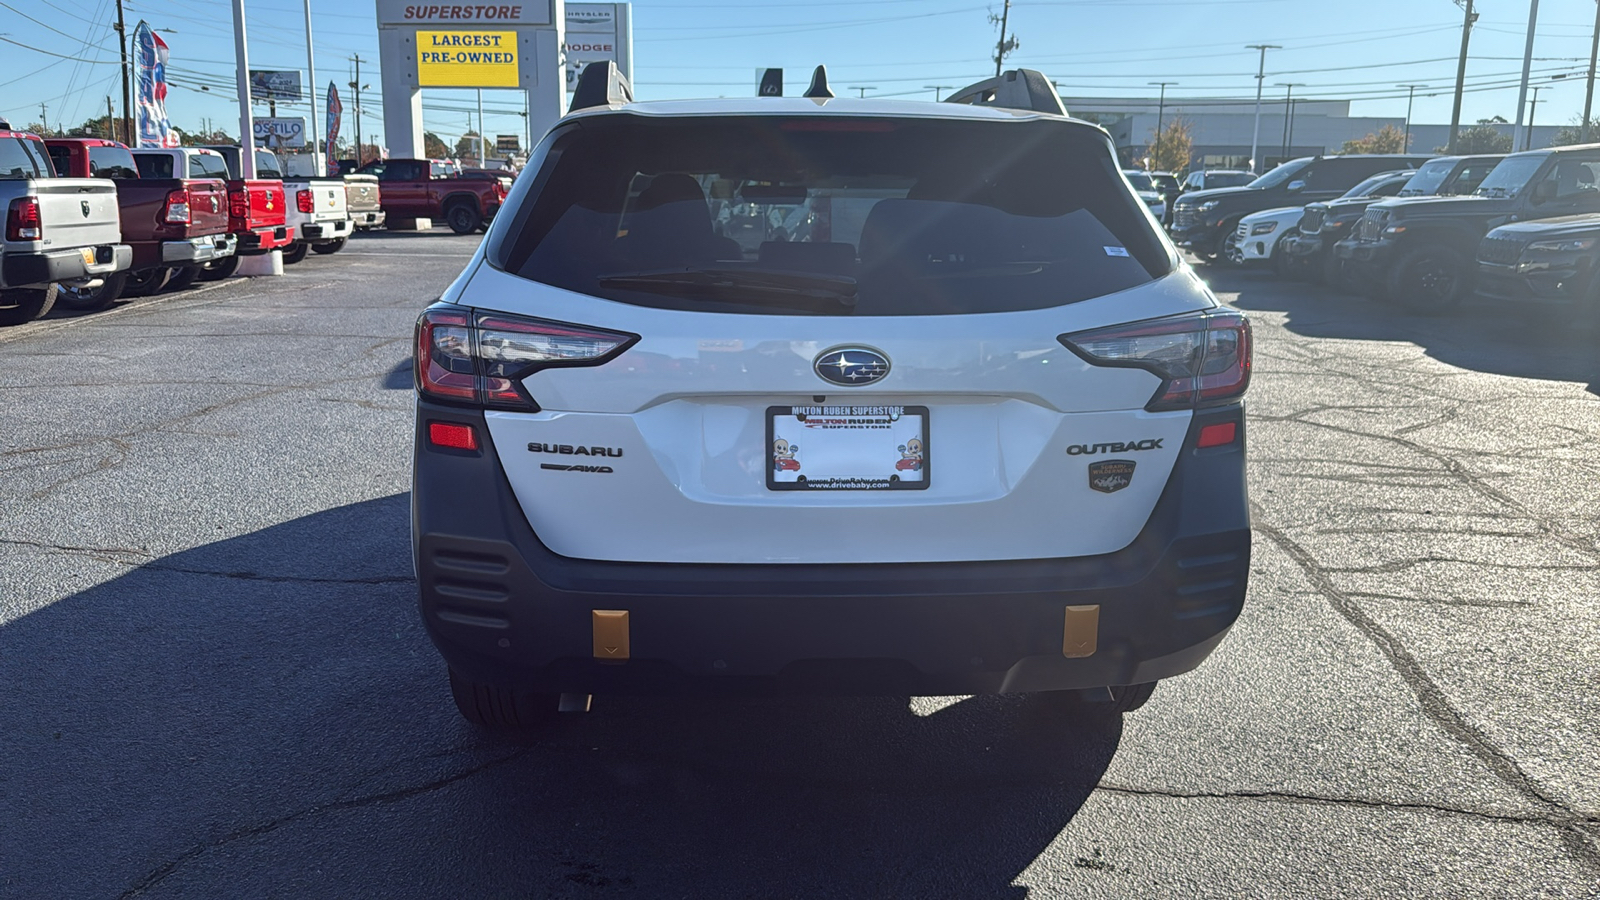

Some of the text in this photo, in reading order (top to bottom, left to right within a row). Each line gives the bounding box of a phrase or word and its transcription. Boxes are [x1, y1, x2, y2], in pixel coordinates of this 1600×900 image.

[404, 5, 522, 19] SUPERSTORE
[432, 35, 502, 47] LARGEST
[421, 52, 514, 64] PRE-OWNED
[792, 407, 905, 415] MILTON RUBEN SUPERSTORE
[527, 442, 622, 457] SUBARU
[1066, 438, 1163, 455] OUTBACK
[567, 465, 613, 473] AWD
[807, 481, 890, 489] www.drivebaby.com
